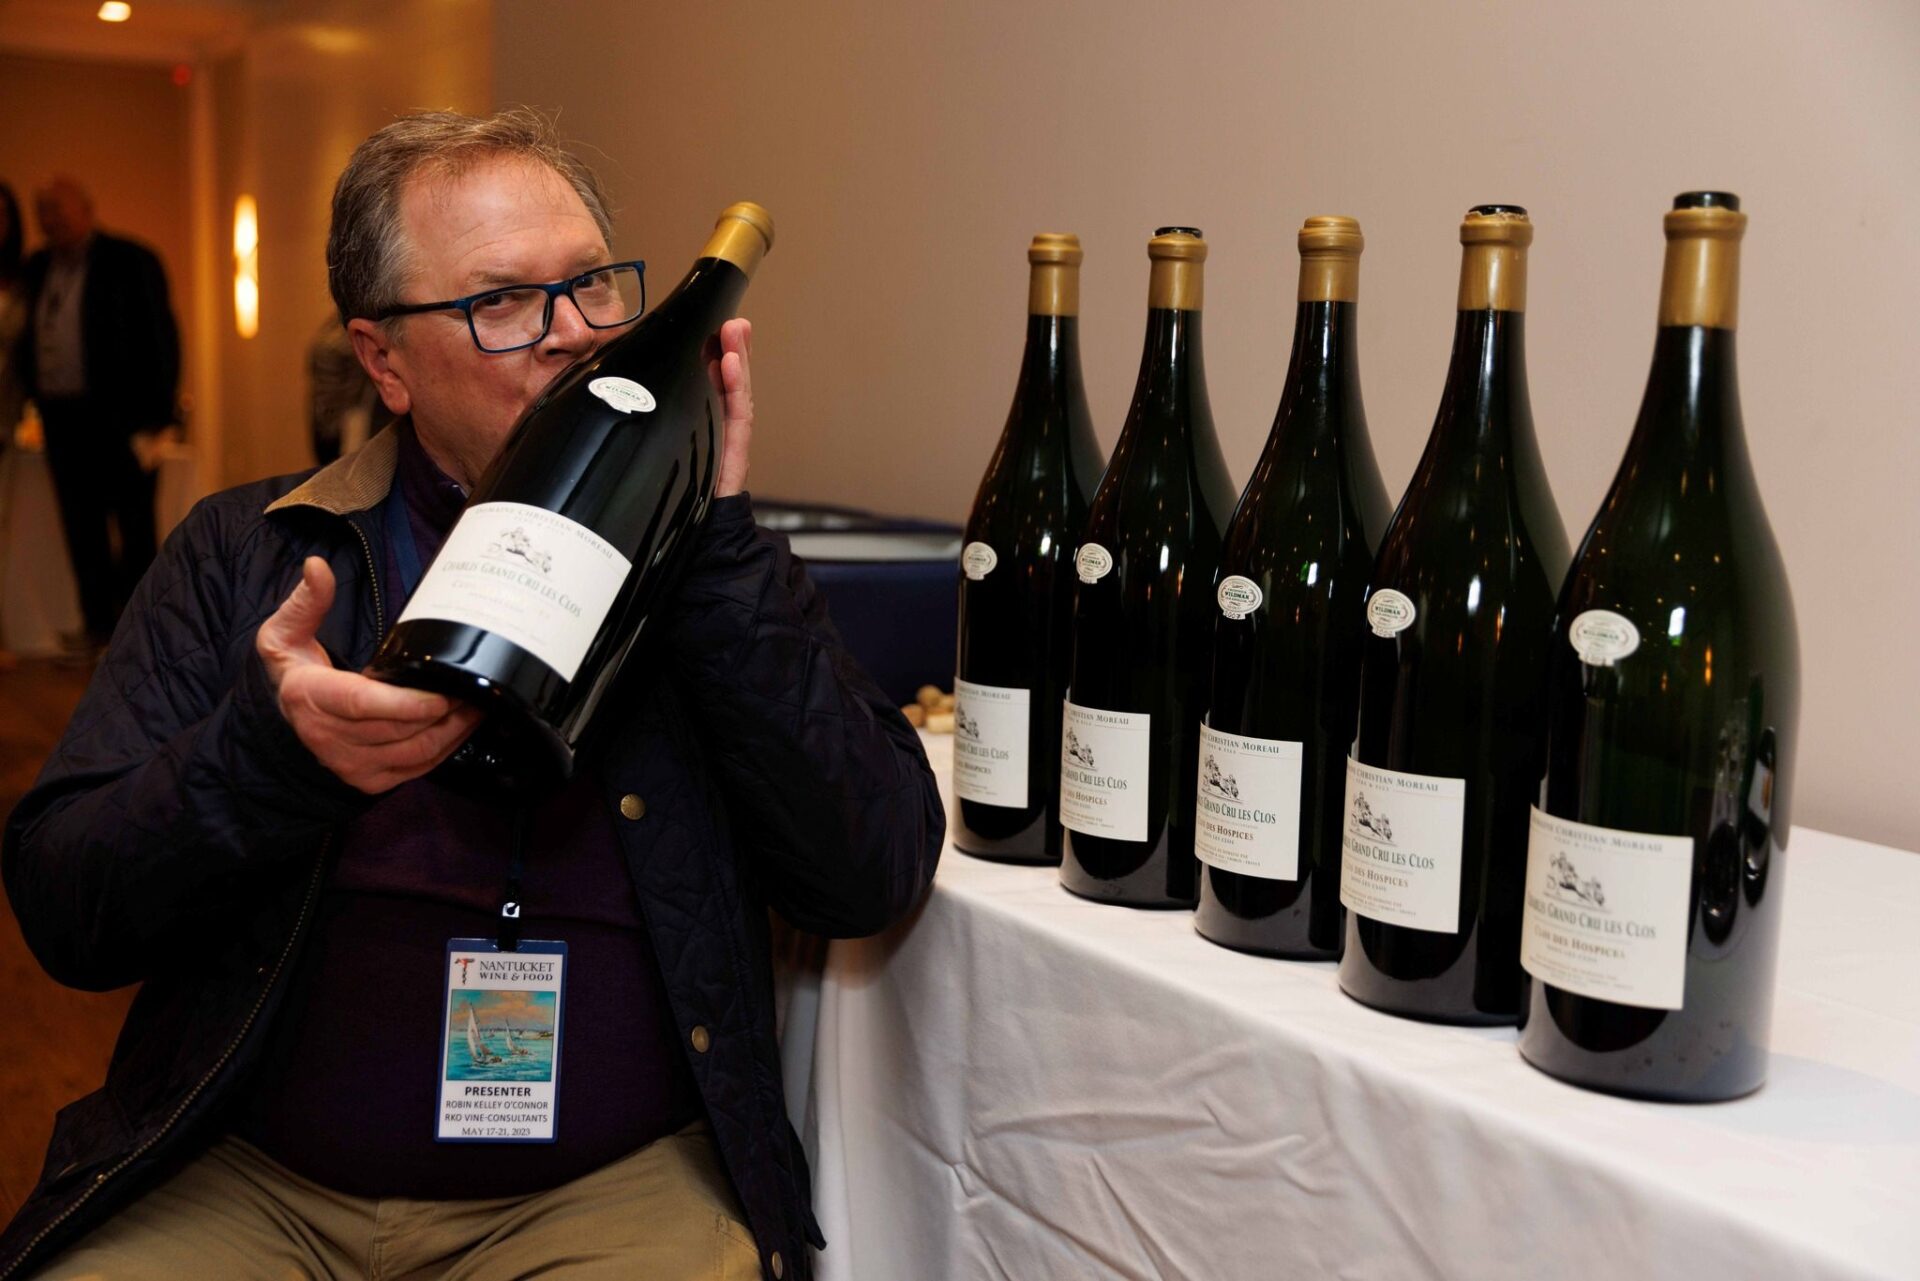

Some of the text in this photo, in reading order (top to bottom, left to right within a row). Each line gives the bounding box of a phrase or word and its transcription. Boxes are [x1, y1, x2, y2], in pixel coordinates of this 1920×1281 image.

[518, 510, 571, 531] CHRISTIAN
[575, 529, 613, 559] MOREAU
[480, 562, 516, 580] GRAND
[517, 572, 540, 590] CRU
[540, 584, 558, 600] LES
[558, 592, 583, 618] CLOS
[1096, 713, 1129, 726] MOREAU
[1207, 734, 1239, 748] CHRISTIAN
[1241, 740, 1280, 754] MOREAU
[990, 747, 1010, 761] CLOS
[1079, 770, 1093, 786] CRU
[1094, 776, 1106, 788] LES
[1107, 776, 1128, 790] CLOS
[1356, 766, 1393, 785] CHRISTIAN
[1396, 778, 1439, 792] MOREAU
[1076, 791, 1108, 806] HOSPICES
[1203, 796, 1220, 814] GRAND
[1222, 803, 1237, 818] CRU
[1238, 808, 1252, 821] LES
[1253, 809, 1276, 824] CLOS
[1217, 824, 1254, 840] HOSPICES
[1555, 824, 1607, 845] CHRISTIAN
[1612, 836, 1663, 853] MOREAU
[1351, 838, 1371, 858] GRAND
[1372, 846, 1390, 862] CRU
[1391, 852, 1407, 866] LES
[1408, 853, 1436, 870] CLOS
[1367, 869, 1409, 888] HOSPICES
[1547, 902, 1578, 926] GRAND
[1578, 912, 1602, 932] CRU
[1604, 920, 1622, 935] LES
[1625, 920, 1657, 940] CLOS
[1572, 938, 1626, 960] HOSPICES
[479, 960, 554, 972] NANTUCKET
[479, 972, 554, 982] WINE & FOOD
[464, 1086, 531, 1097] PRESENTER
[446, 1100, 548, 1110] ROBIN KELLEY O'CONNOR
[445, 1114, 548, 1123] RKO VINE-CONSULTANTS
[462, 1127, 531, 1138] MAY 17-21, 2023
